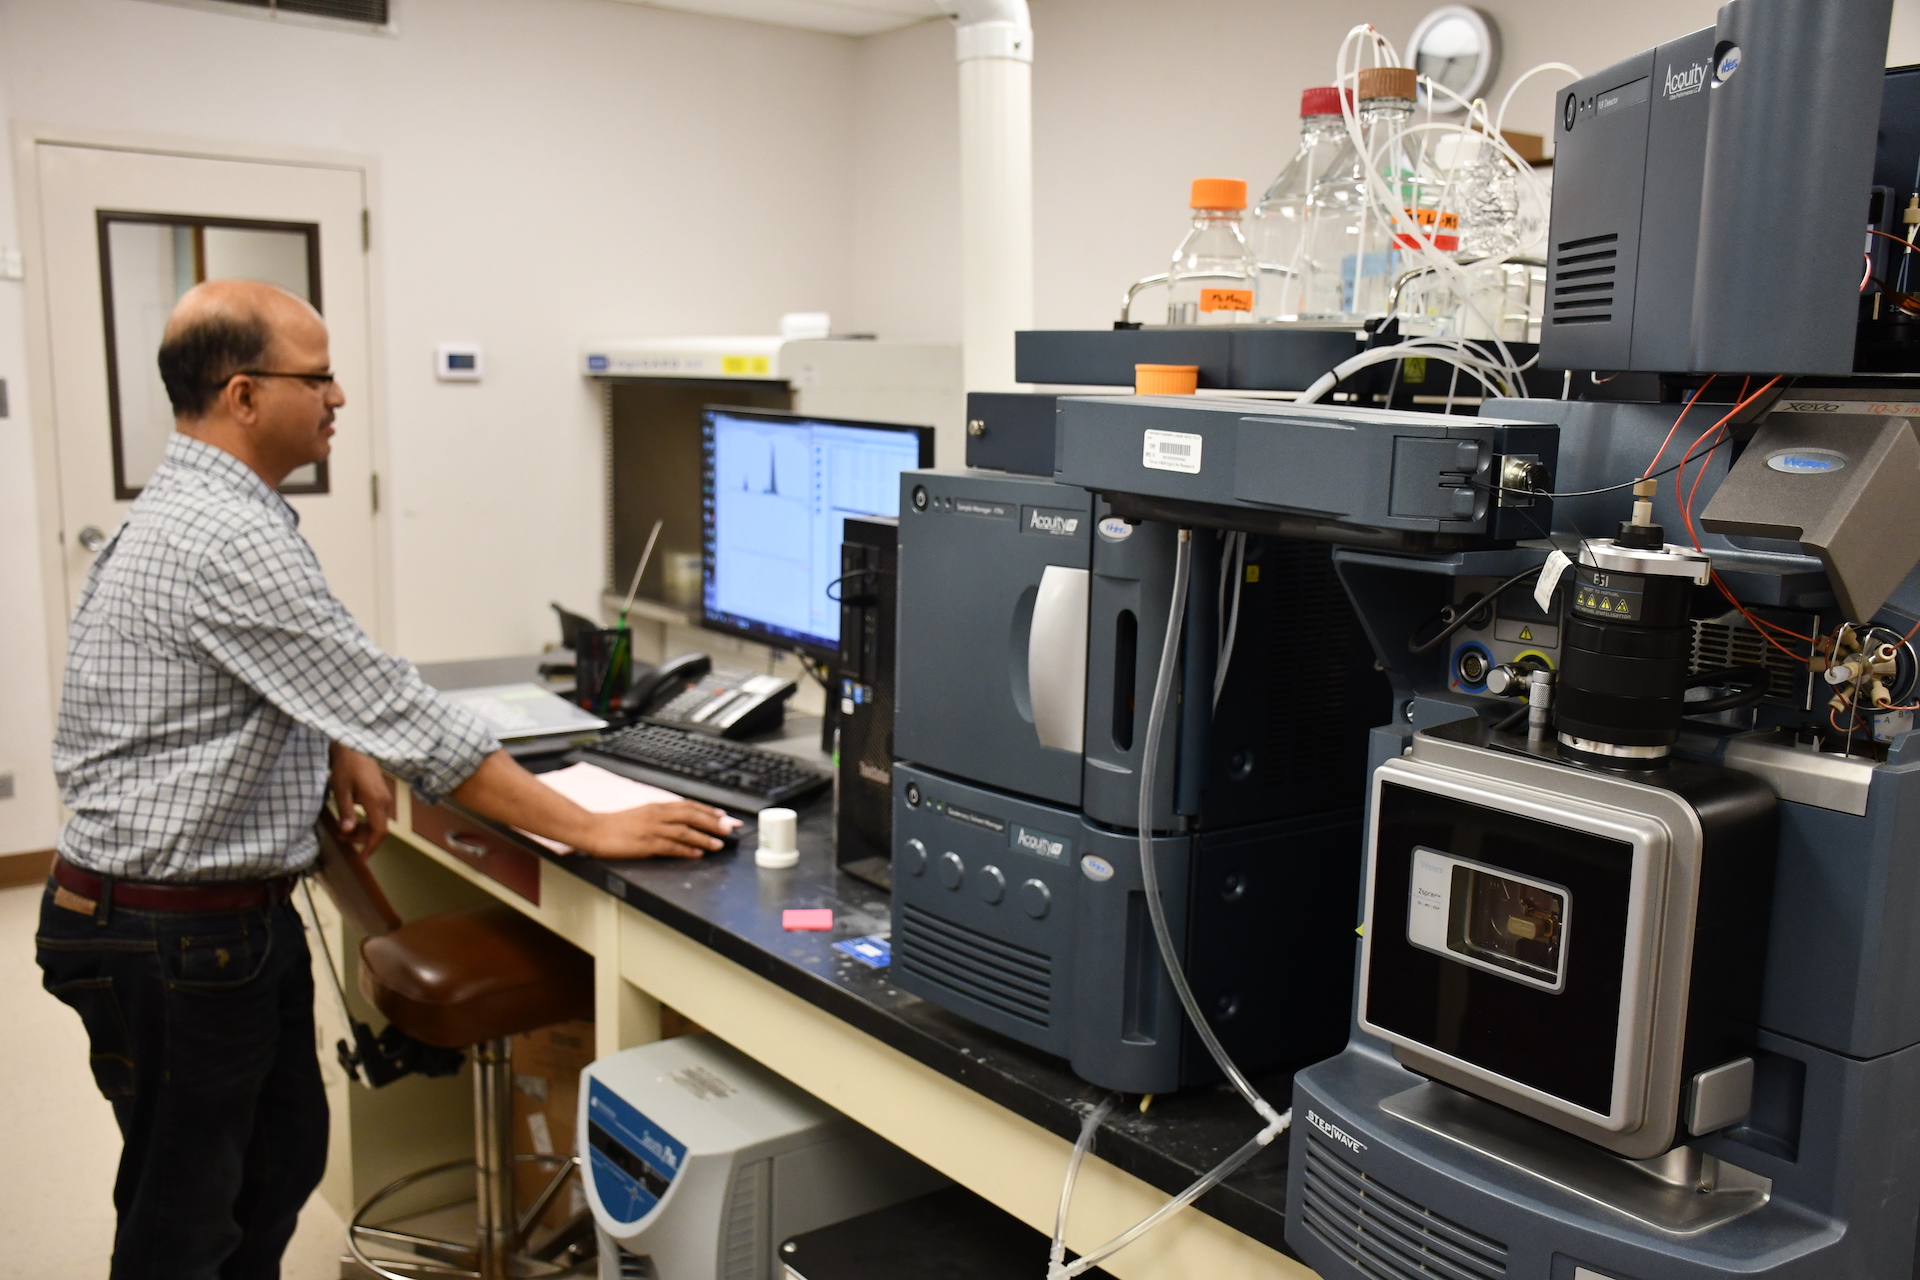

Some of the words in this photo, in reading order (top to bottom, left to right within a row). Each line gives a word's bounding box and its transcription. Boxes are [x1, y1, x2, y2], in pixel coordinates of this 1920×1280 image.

[1867, 403, 1903, 415] TQ-S
[1783, 456, 1831, 470] Waters
[1030, 508, 1066, 536] Acquity
[1883, 716, 1890, 724] A
[1017, 827, 1051, 857] Acquity
